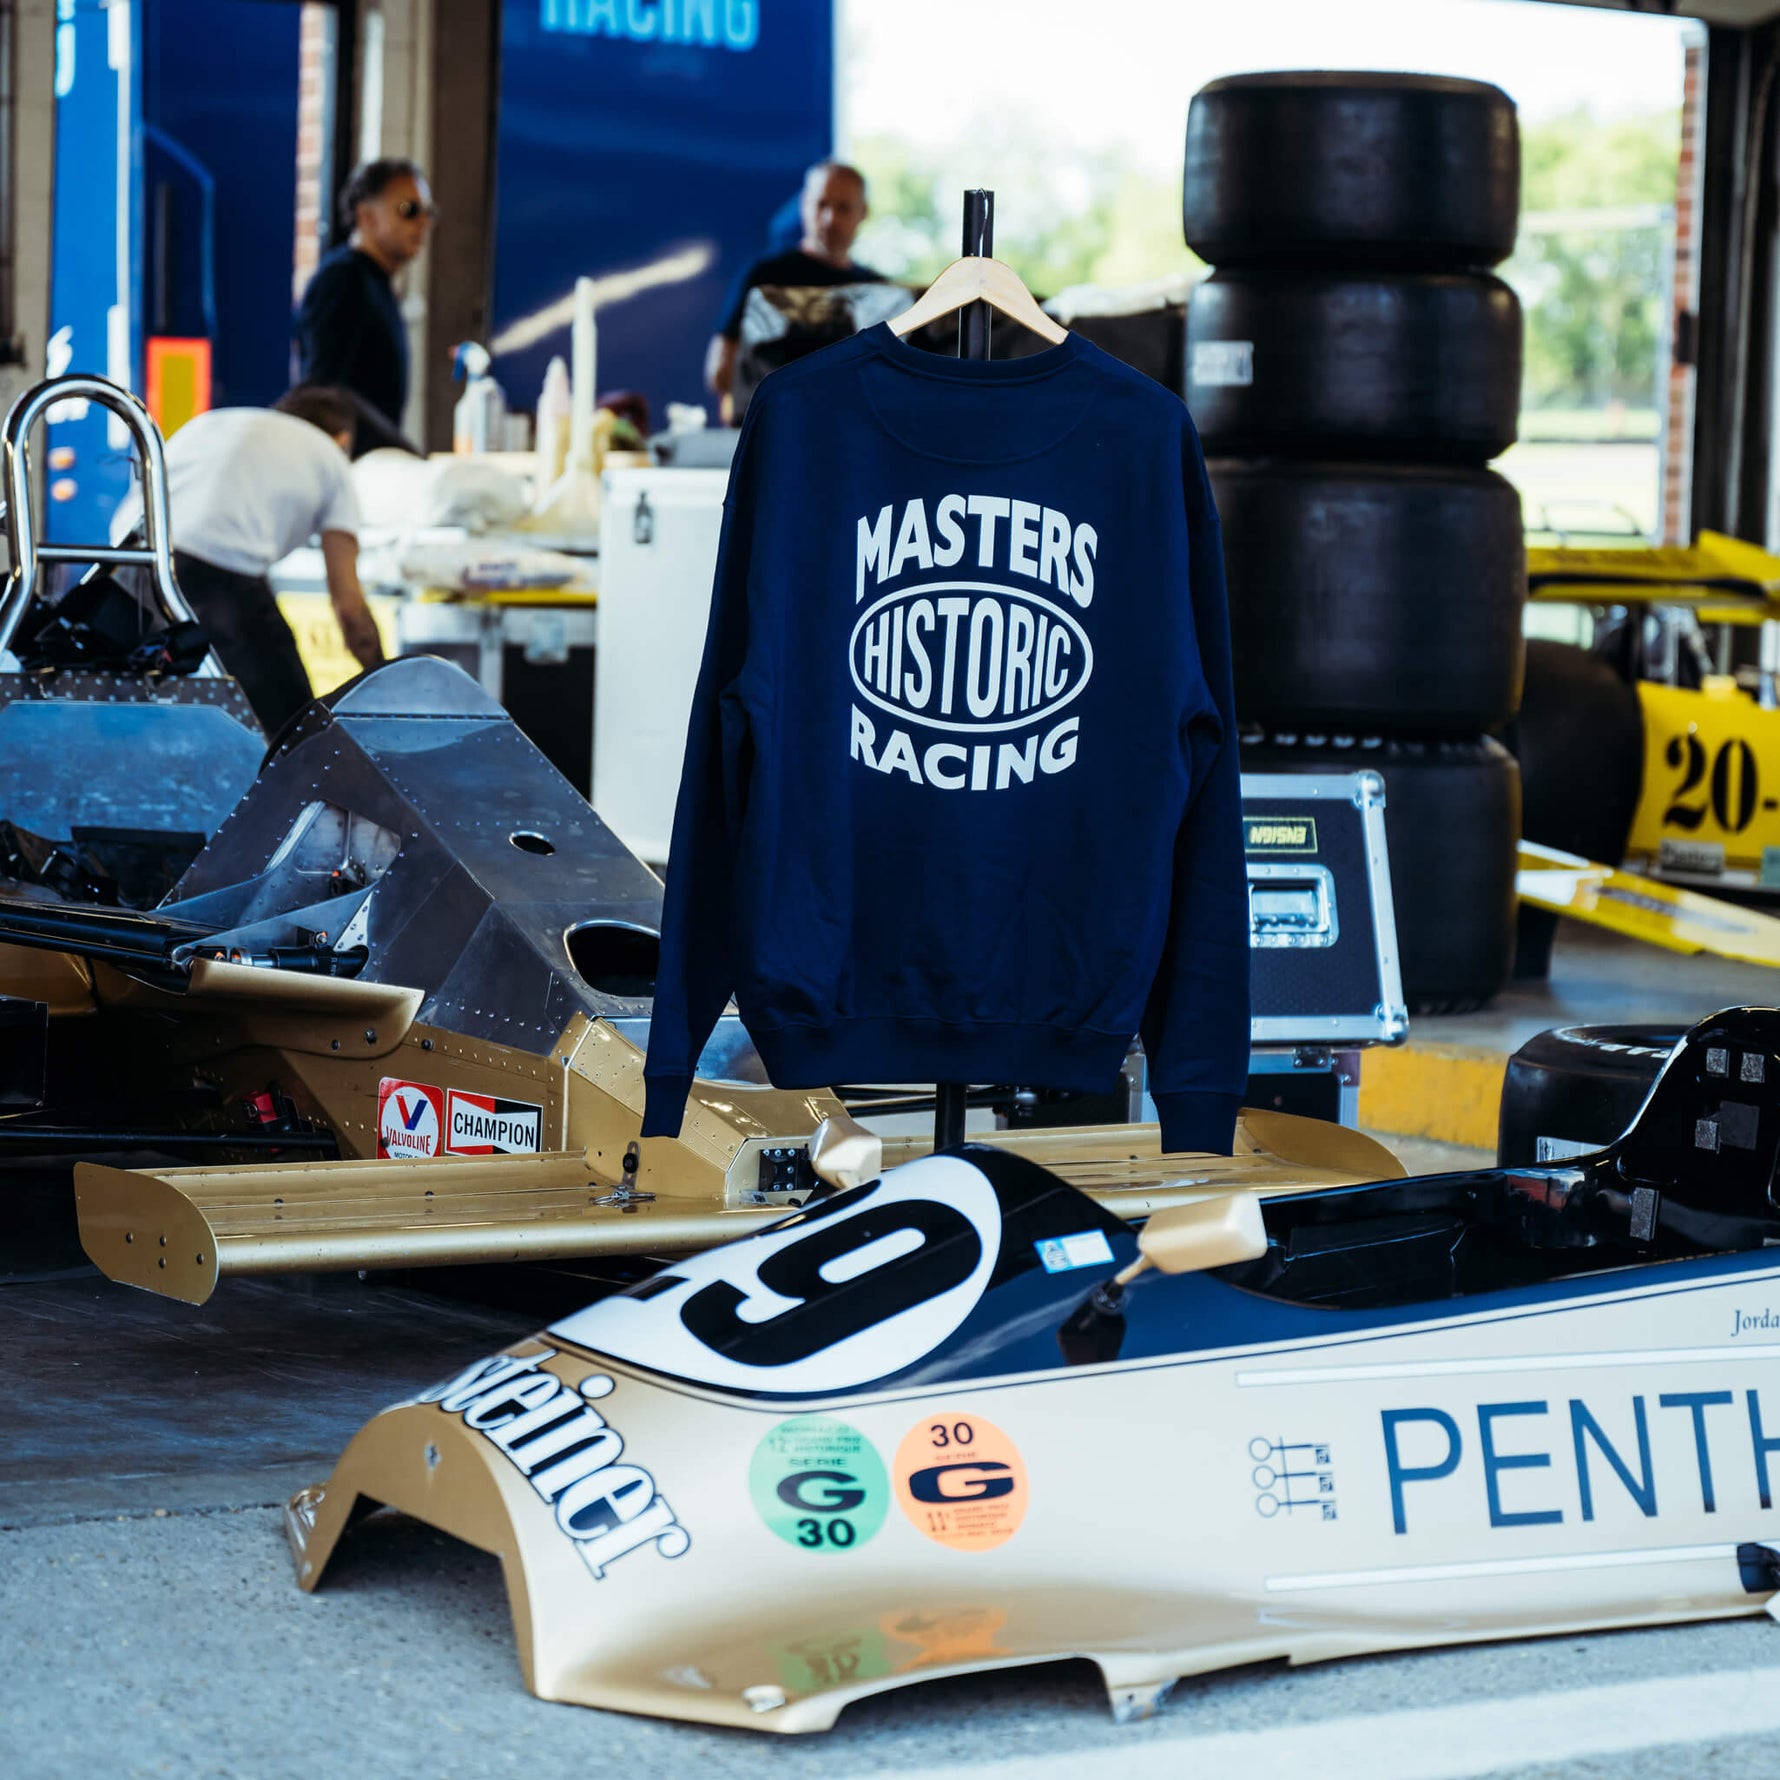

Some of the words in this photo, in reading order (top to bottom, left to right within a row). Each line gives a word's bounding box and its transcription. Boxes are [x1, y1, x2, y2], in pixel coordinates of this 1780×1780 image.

[856, 494, 1098, 608] MASTERS
[864, 597, 1071, 718] HISTORIC
[850, 703, 1079, 791] RACING
[386, 1125, 431, 1155] VALVOLINE
[453, 1112, 535, 1148] CHAMPION
[1731, 1308, 1780, 1337] Jorda
[931, 1422, 973, 1447] 30
[777, 1470, 866, 1514] G
[909, 1461, 1014, 1504] G
[798, 1518, 856, 1548] 30
